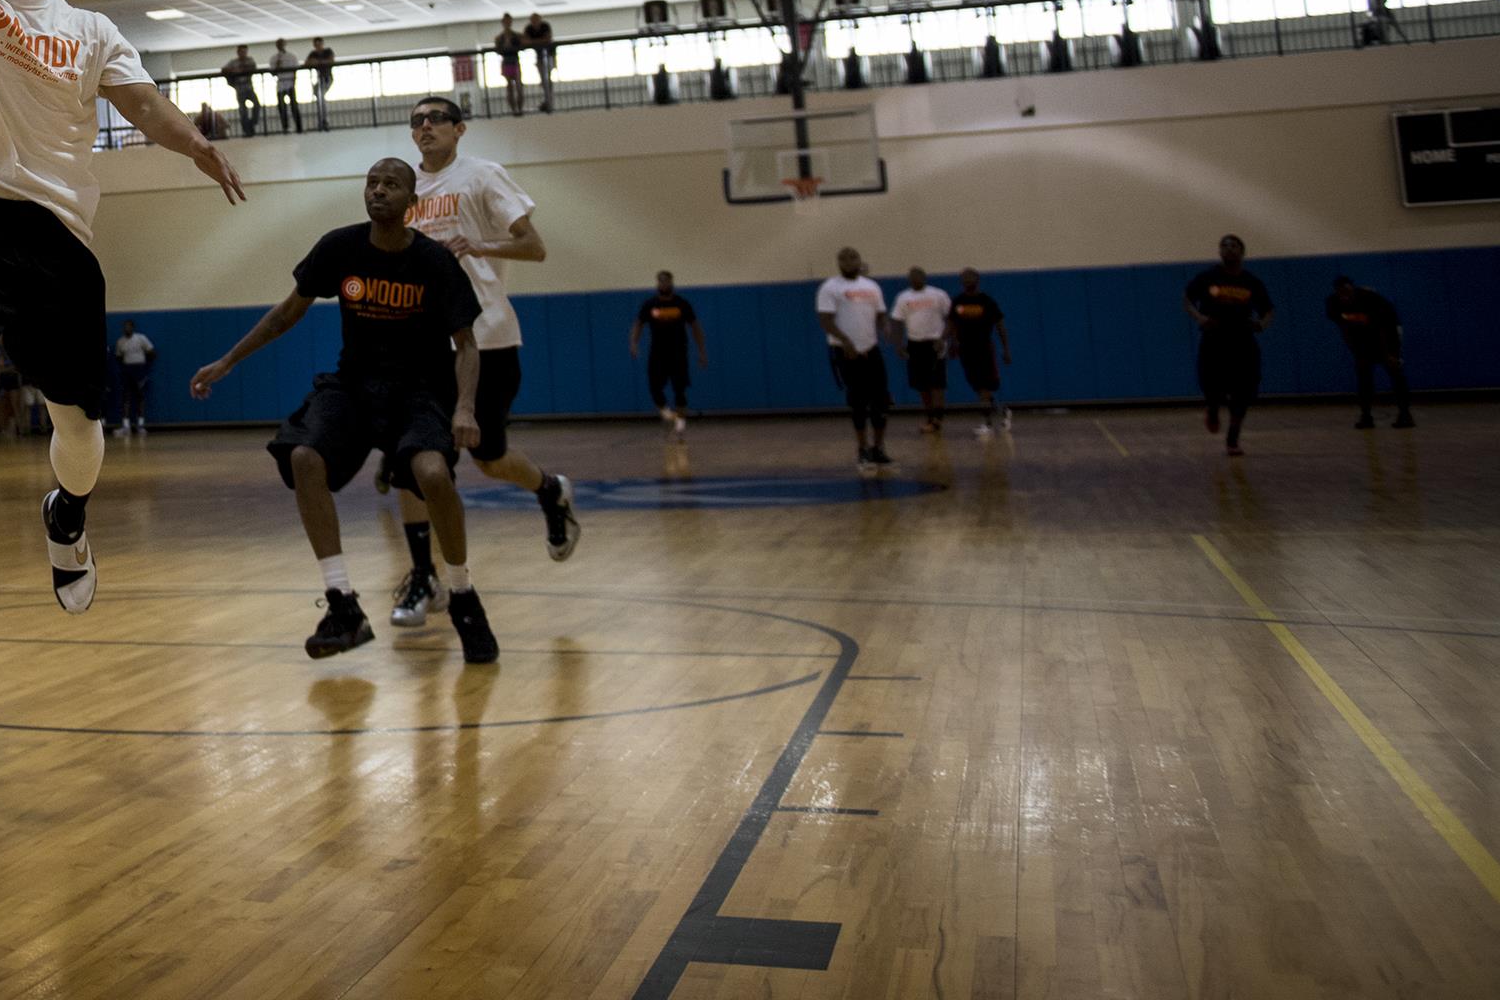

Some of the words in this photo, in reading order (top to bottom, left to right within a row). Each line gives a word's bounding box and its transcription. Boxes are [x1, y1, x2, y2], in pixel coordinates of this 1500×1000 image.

[4, 43, 38, 66] INTERESTS
[1410, 148, 1457, 164] HOME
[404, 194, 460, 227] MOODY
